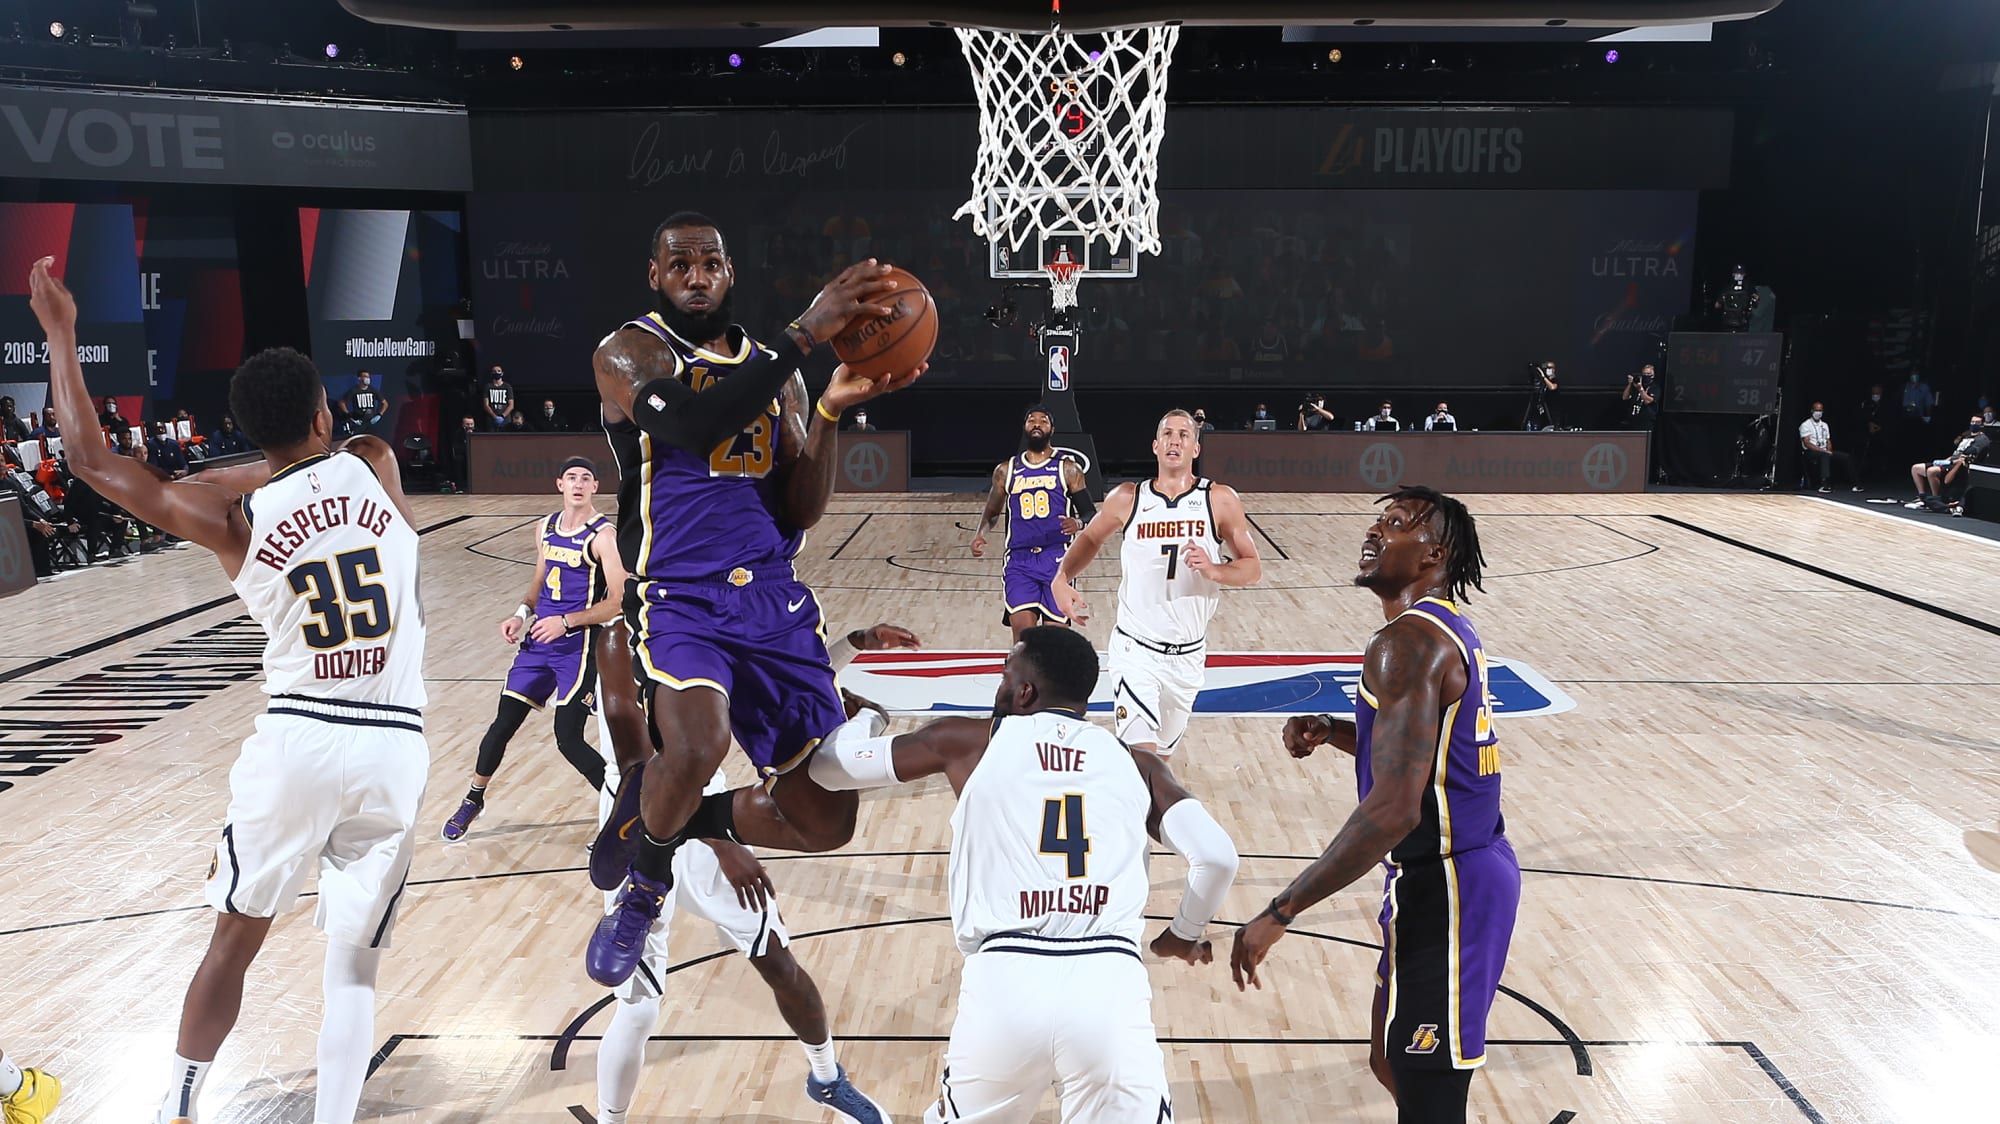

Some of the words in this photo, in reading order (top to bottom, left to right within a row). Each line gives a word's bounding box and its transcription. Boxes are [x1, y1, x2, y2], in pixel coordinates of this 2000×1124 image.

[1, 105, 225, 170] VOTE
[302, 129, 377, 152] oculus
[1373, 127, 1523, 174] PLAYOFFS
[482, 258, 569, 279] ULTRA
[1591, 256, 1679, 277] ULTRA
[4, 341, 50, 364] 2019-2
[77, 344, 110, 363] ason
[345, 337, 436, 358] #WholeNewGame
[356, 393, 374, 408] VOTE
[490, 389, 507, 404] VOTE
[1223, 454, 1353, 479] Autotrader
[1445, 454, 1576, 480] Autotrader
[1020, 490, 1050, 519] 88
[255, 496, 351, 572] RESPECT
[357, 498, 393, 538] US
[1137, 520, 1206, 540] NUGGETS
[1161, 544, 1179, 580] 7
[285, 544, 394, 650] 35
[546, 566, 561, 600] 4
[314, 646, 386, 680] DOZIER
[1035, 742, 1087, 772] VOTE
[1037, 791, 1093, 880] 4
[1019, 884, 1110, 920] MILLSAP
